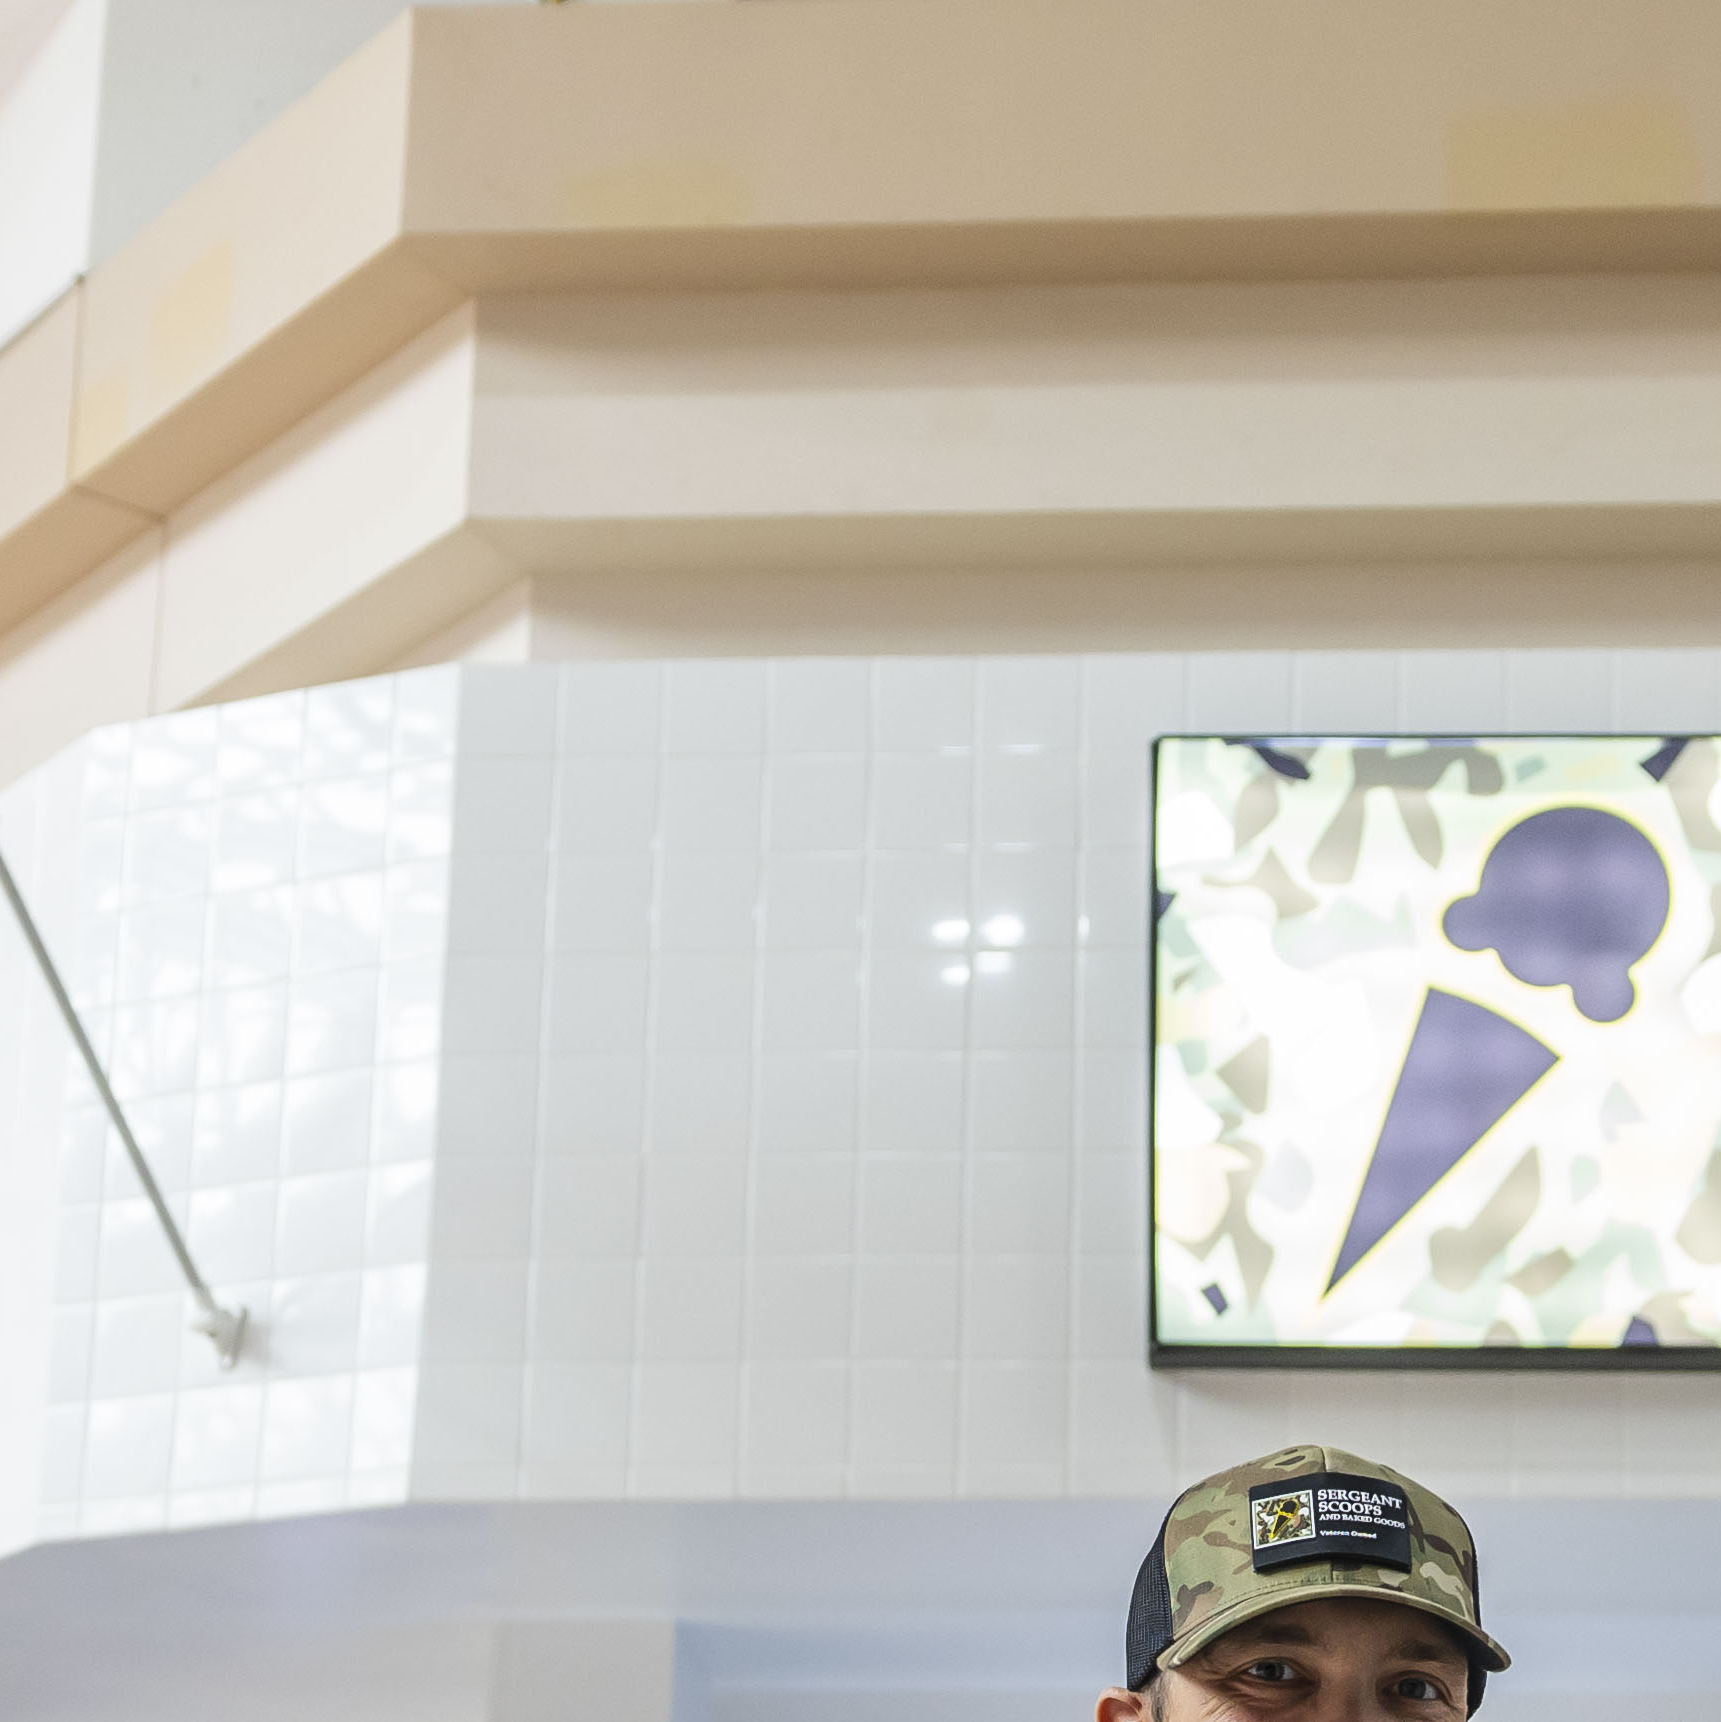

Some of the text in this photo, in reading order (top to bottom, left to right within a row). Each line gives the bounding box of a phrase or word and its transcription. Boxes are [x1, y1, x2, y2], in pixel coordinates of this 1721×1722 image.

[1318, 1489, 1402, 1509] SERGEANT
[1319, 1501, 1382, 1515] SCOOPS
[1342, 1514, 1372, 1522] BAKED
[1374, 1518, 1405, 1528] GOODS
